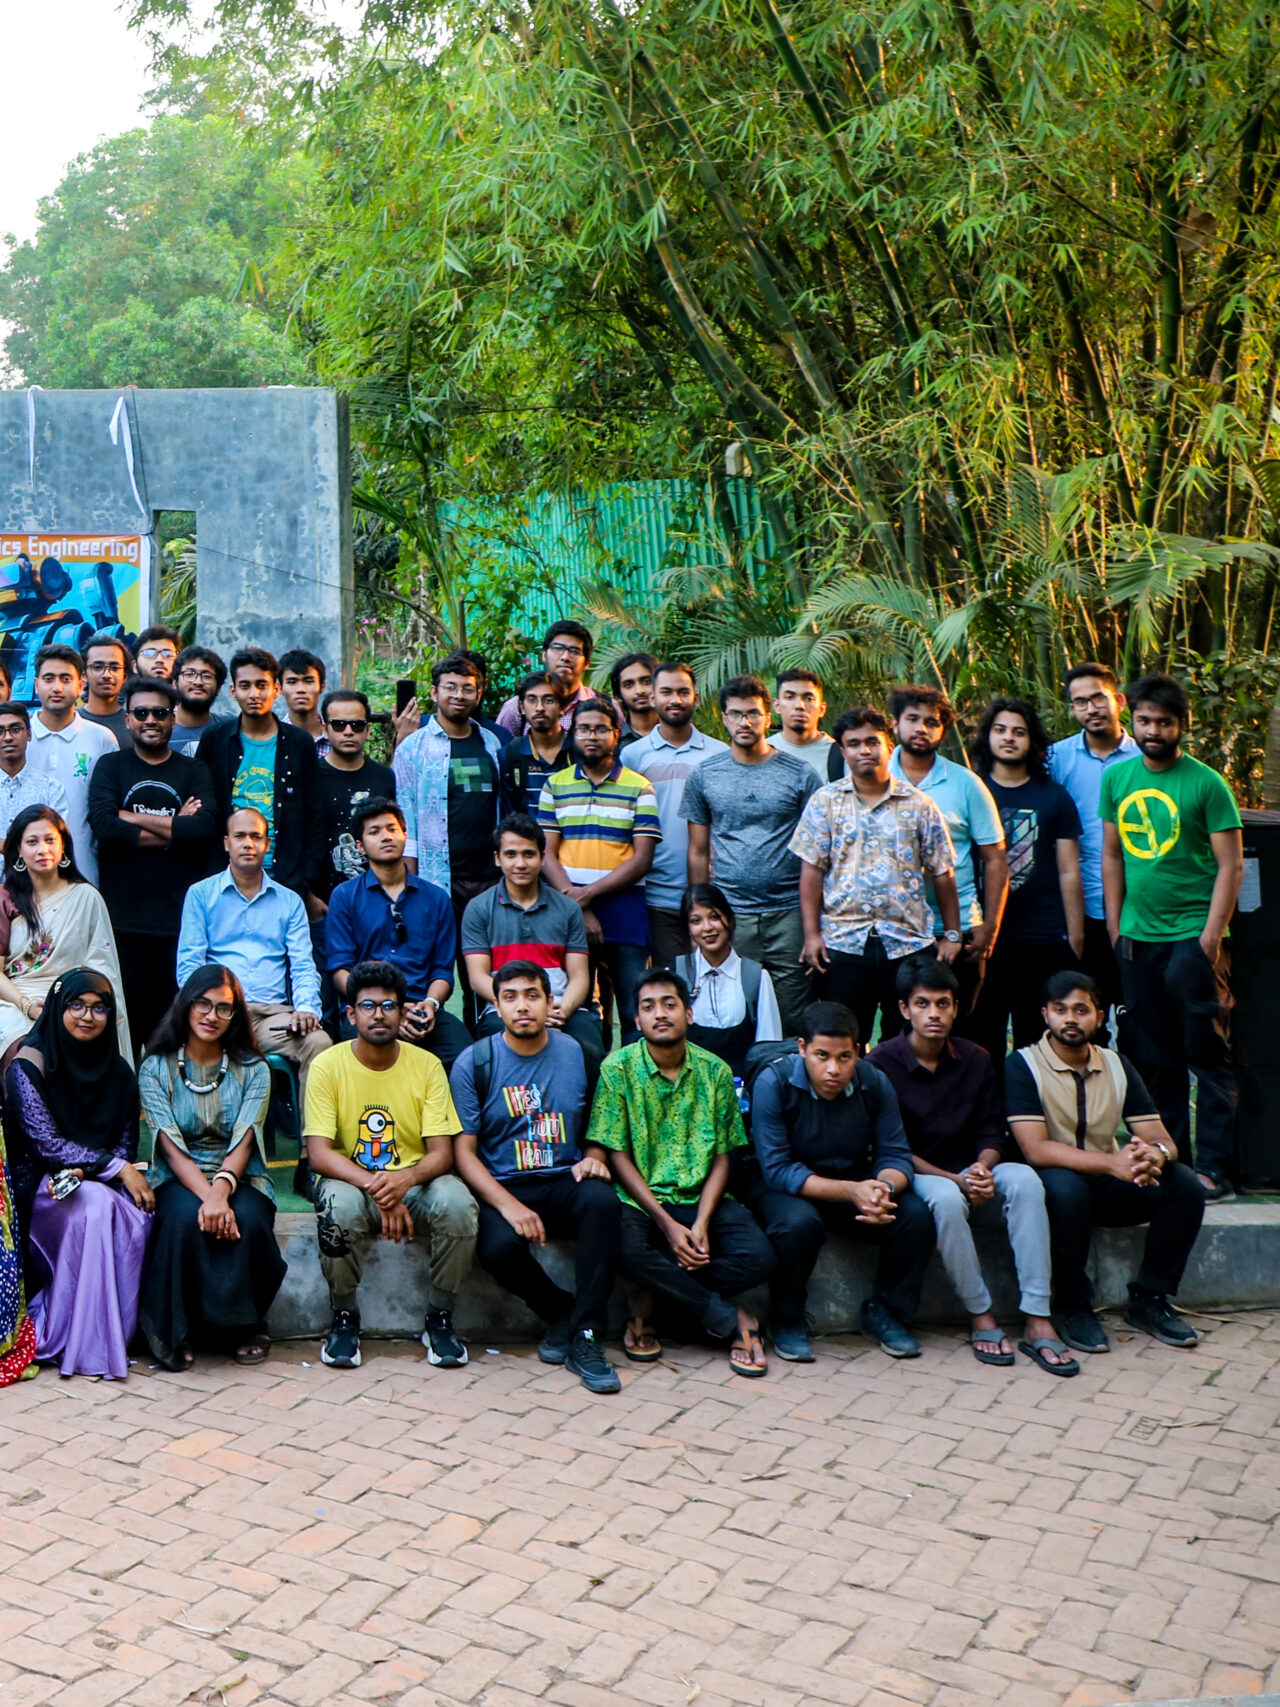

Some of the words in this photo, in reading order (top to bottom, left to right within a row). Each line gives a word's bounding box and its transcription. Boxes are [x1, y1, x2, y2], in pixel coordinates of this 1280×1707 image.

[28, 535, 138, 563] Engineering
[512, 1088, 542, 1111] YES
[530, 1118, 561, 1138] YOU
[522, 1147, 554, 1168] CAN
